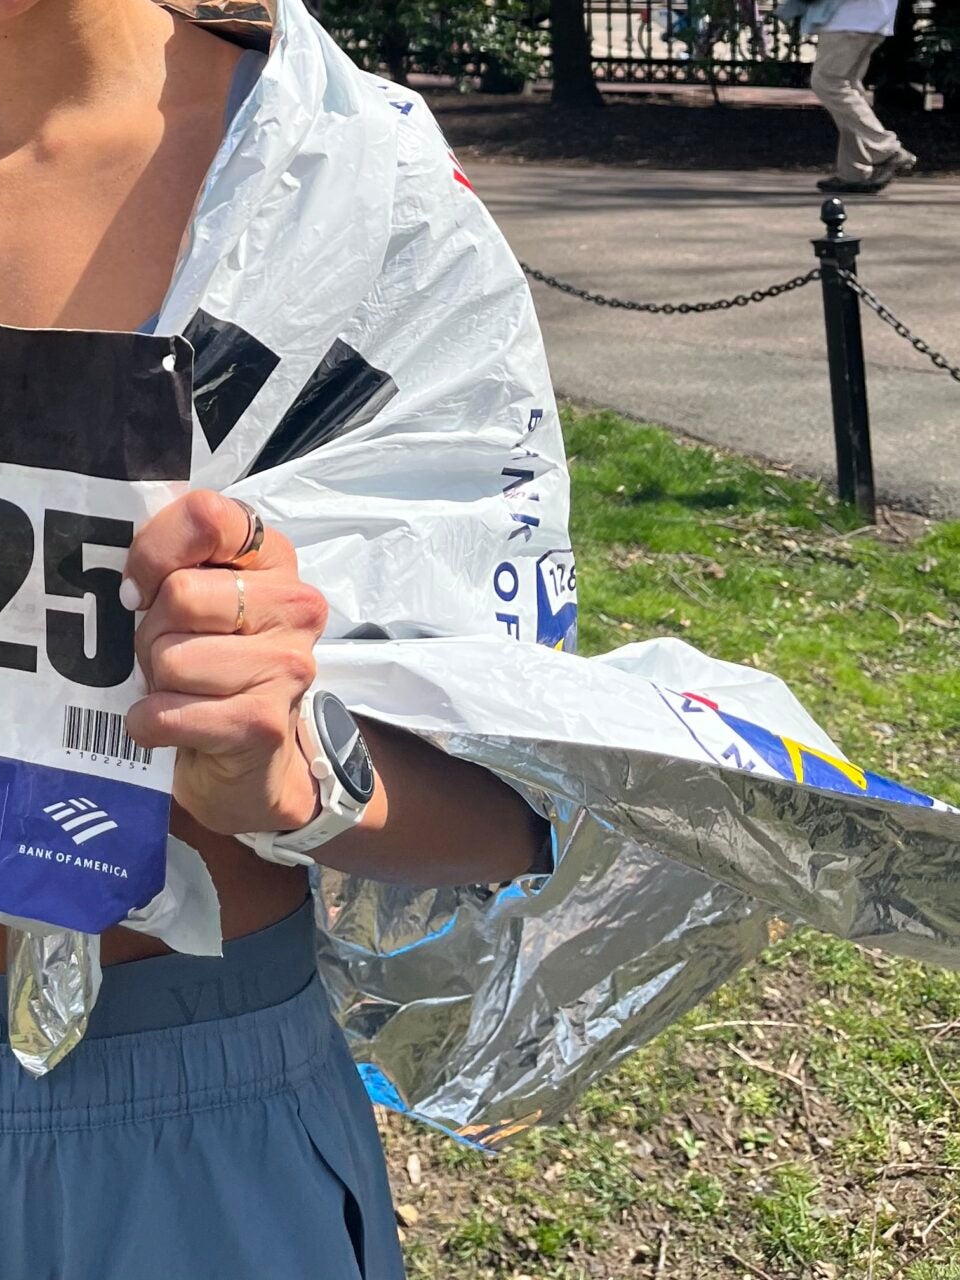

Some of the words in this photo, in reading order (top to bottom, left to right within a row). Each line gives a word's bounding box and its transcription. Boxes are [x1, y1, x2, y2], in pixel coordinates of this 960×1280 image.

[494, 561, 520, 641] OF
[18, 844, 53, 860] BANK
[55, 852, 72, 864] OF
[73, 856, 129, 879] AMERICA
